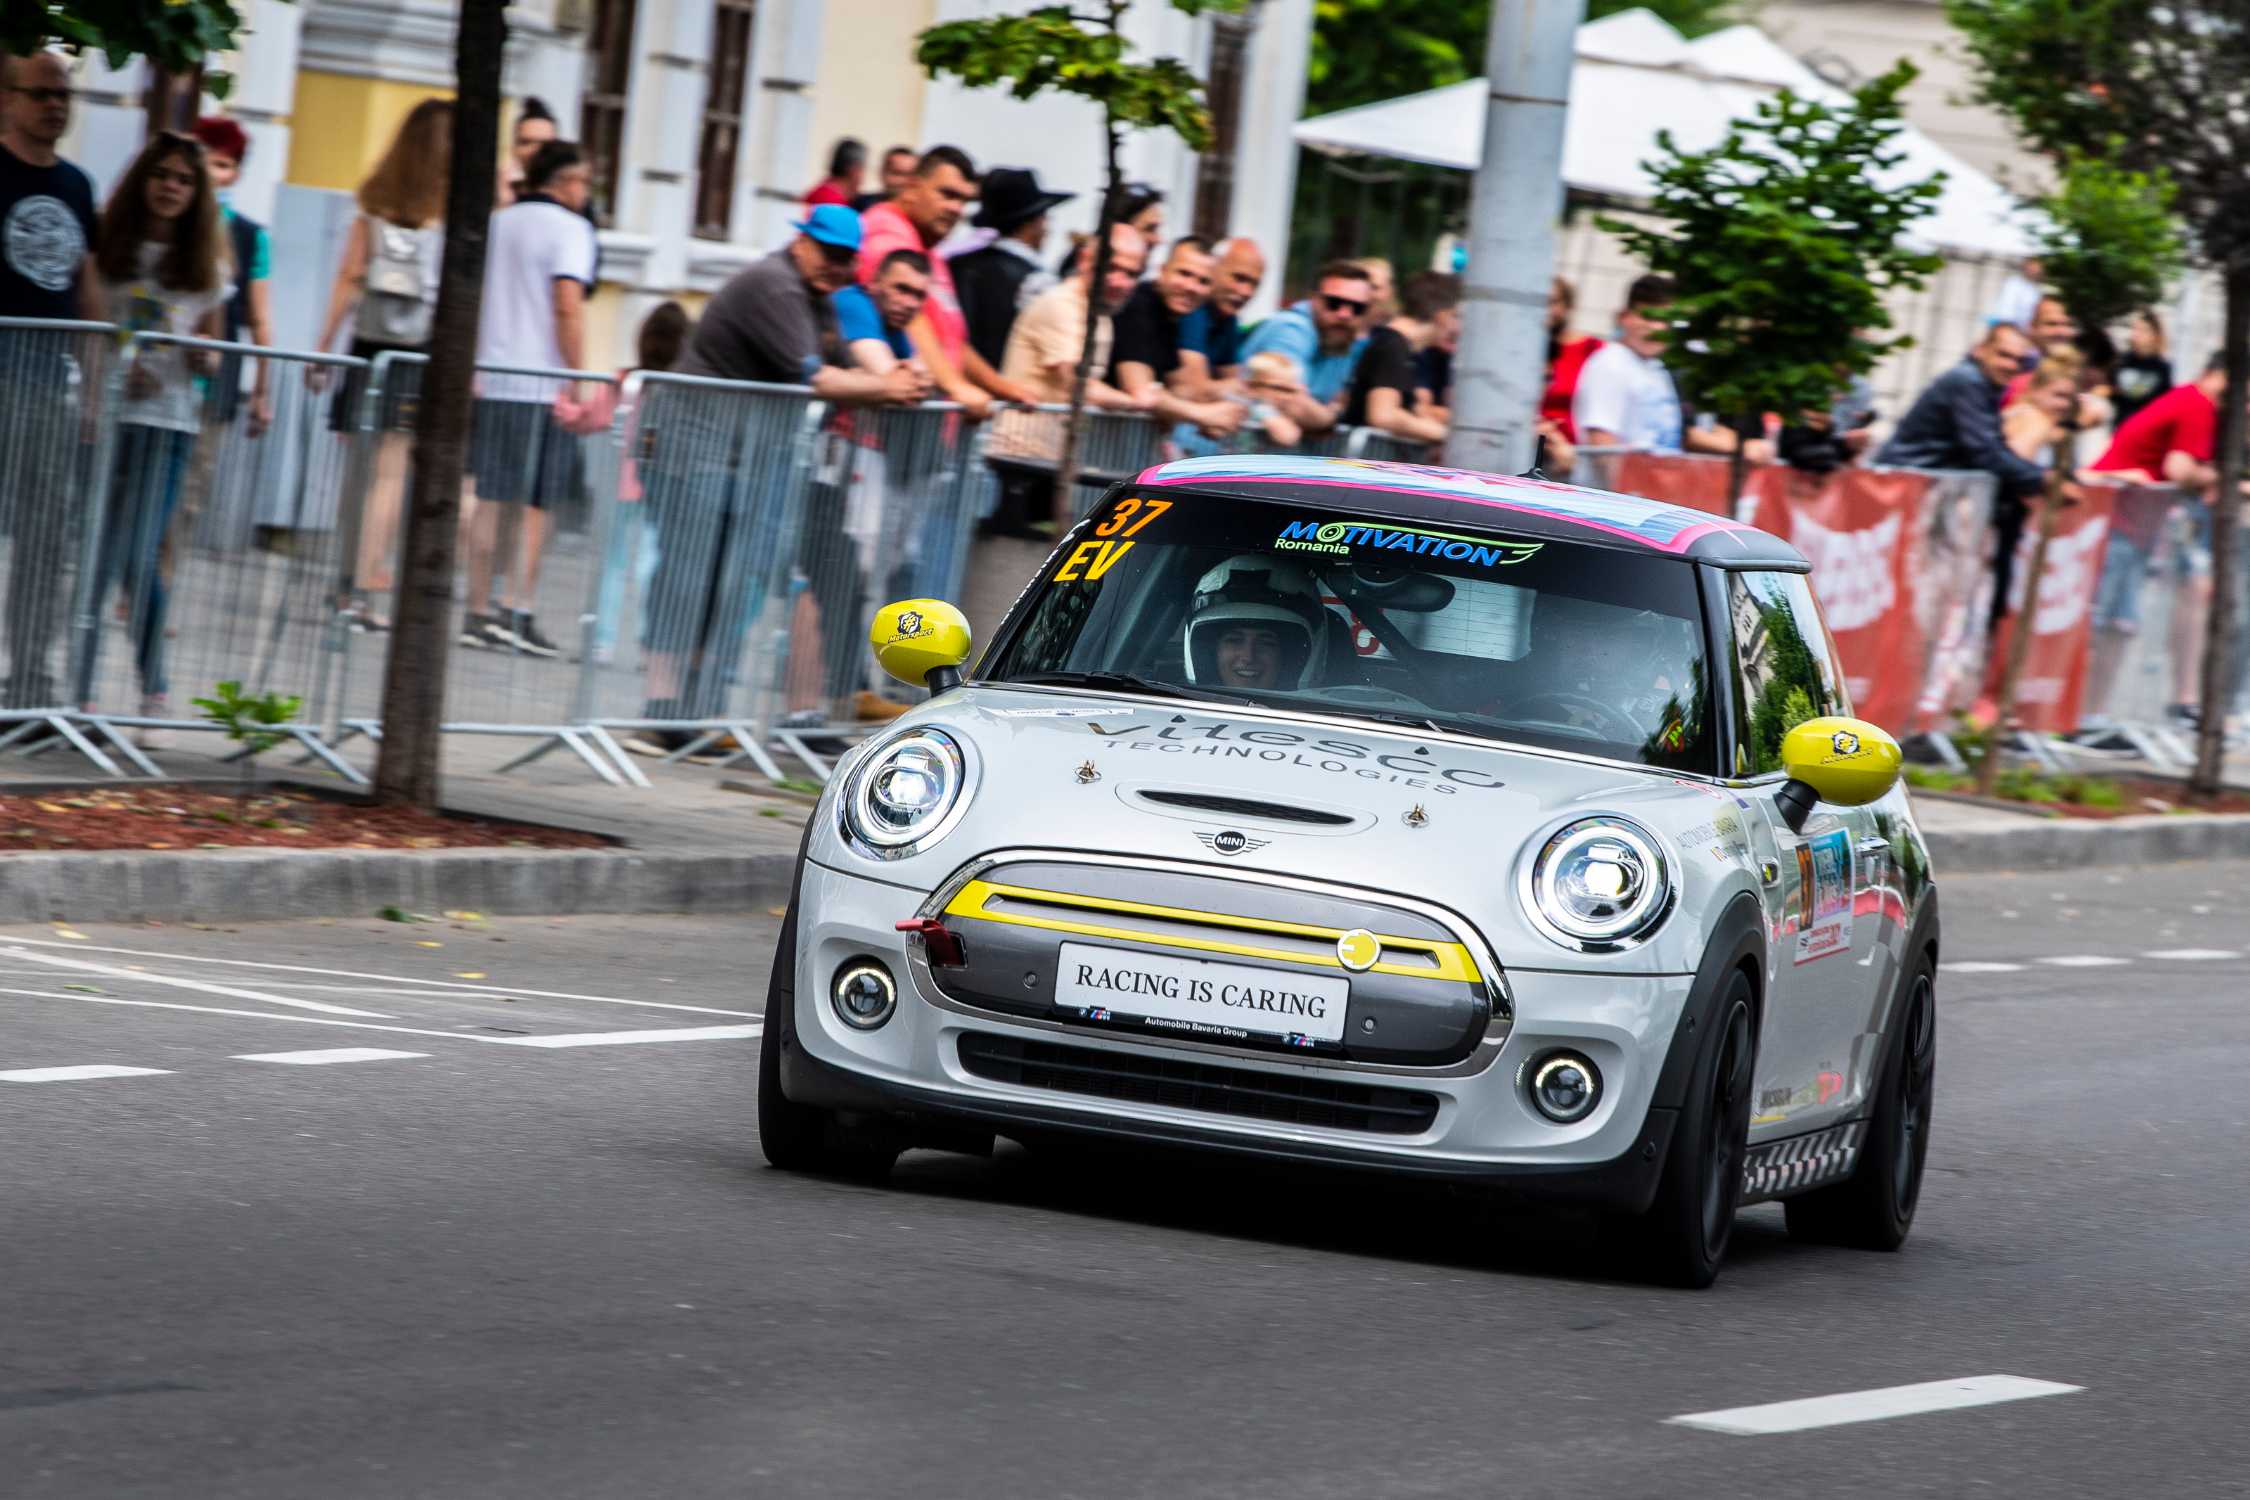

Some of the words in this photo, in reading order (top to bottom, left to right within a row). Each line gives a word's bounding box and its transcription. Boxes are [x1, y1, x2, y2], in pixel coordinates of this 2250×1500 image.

[1095, 498, 1174, 537] 37
[1053, 541, 1136, 582] EV
[1274, 538, 1351, 555] Romania
[1279, 521, 1502, 567] MOTIVATION
[1104, 740, 1458, 795] TECHNOLOGIES
[1216, 836, 1244, 847] MINI
[1075, 964, 1180, 999] RACING
[1186, 979, 1214, 1003] IS
[1220, 985, 1327, 1019] CARING
[1145, 1016, 1191, 1031] Automobile
[1191, 1022, 1222, 1035] Bavaria
[1222, 1026, 1248, 1039] Group
